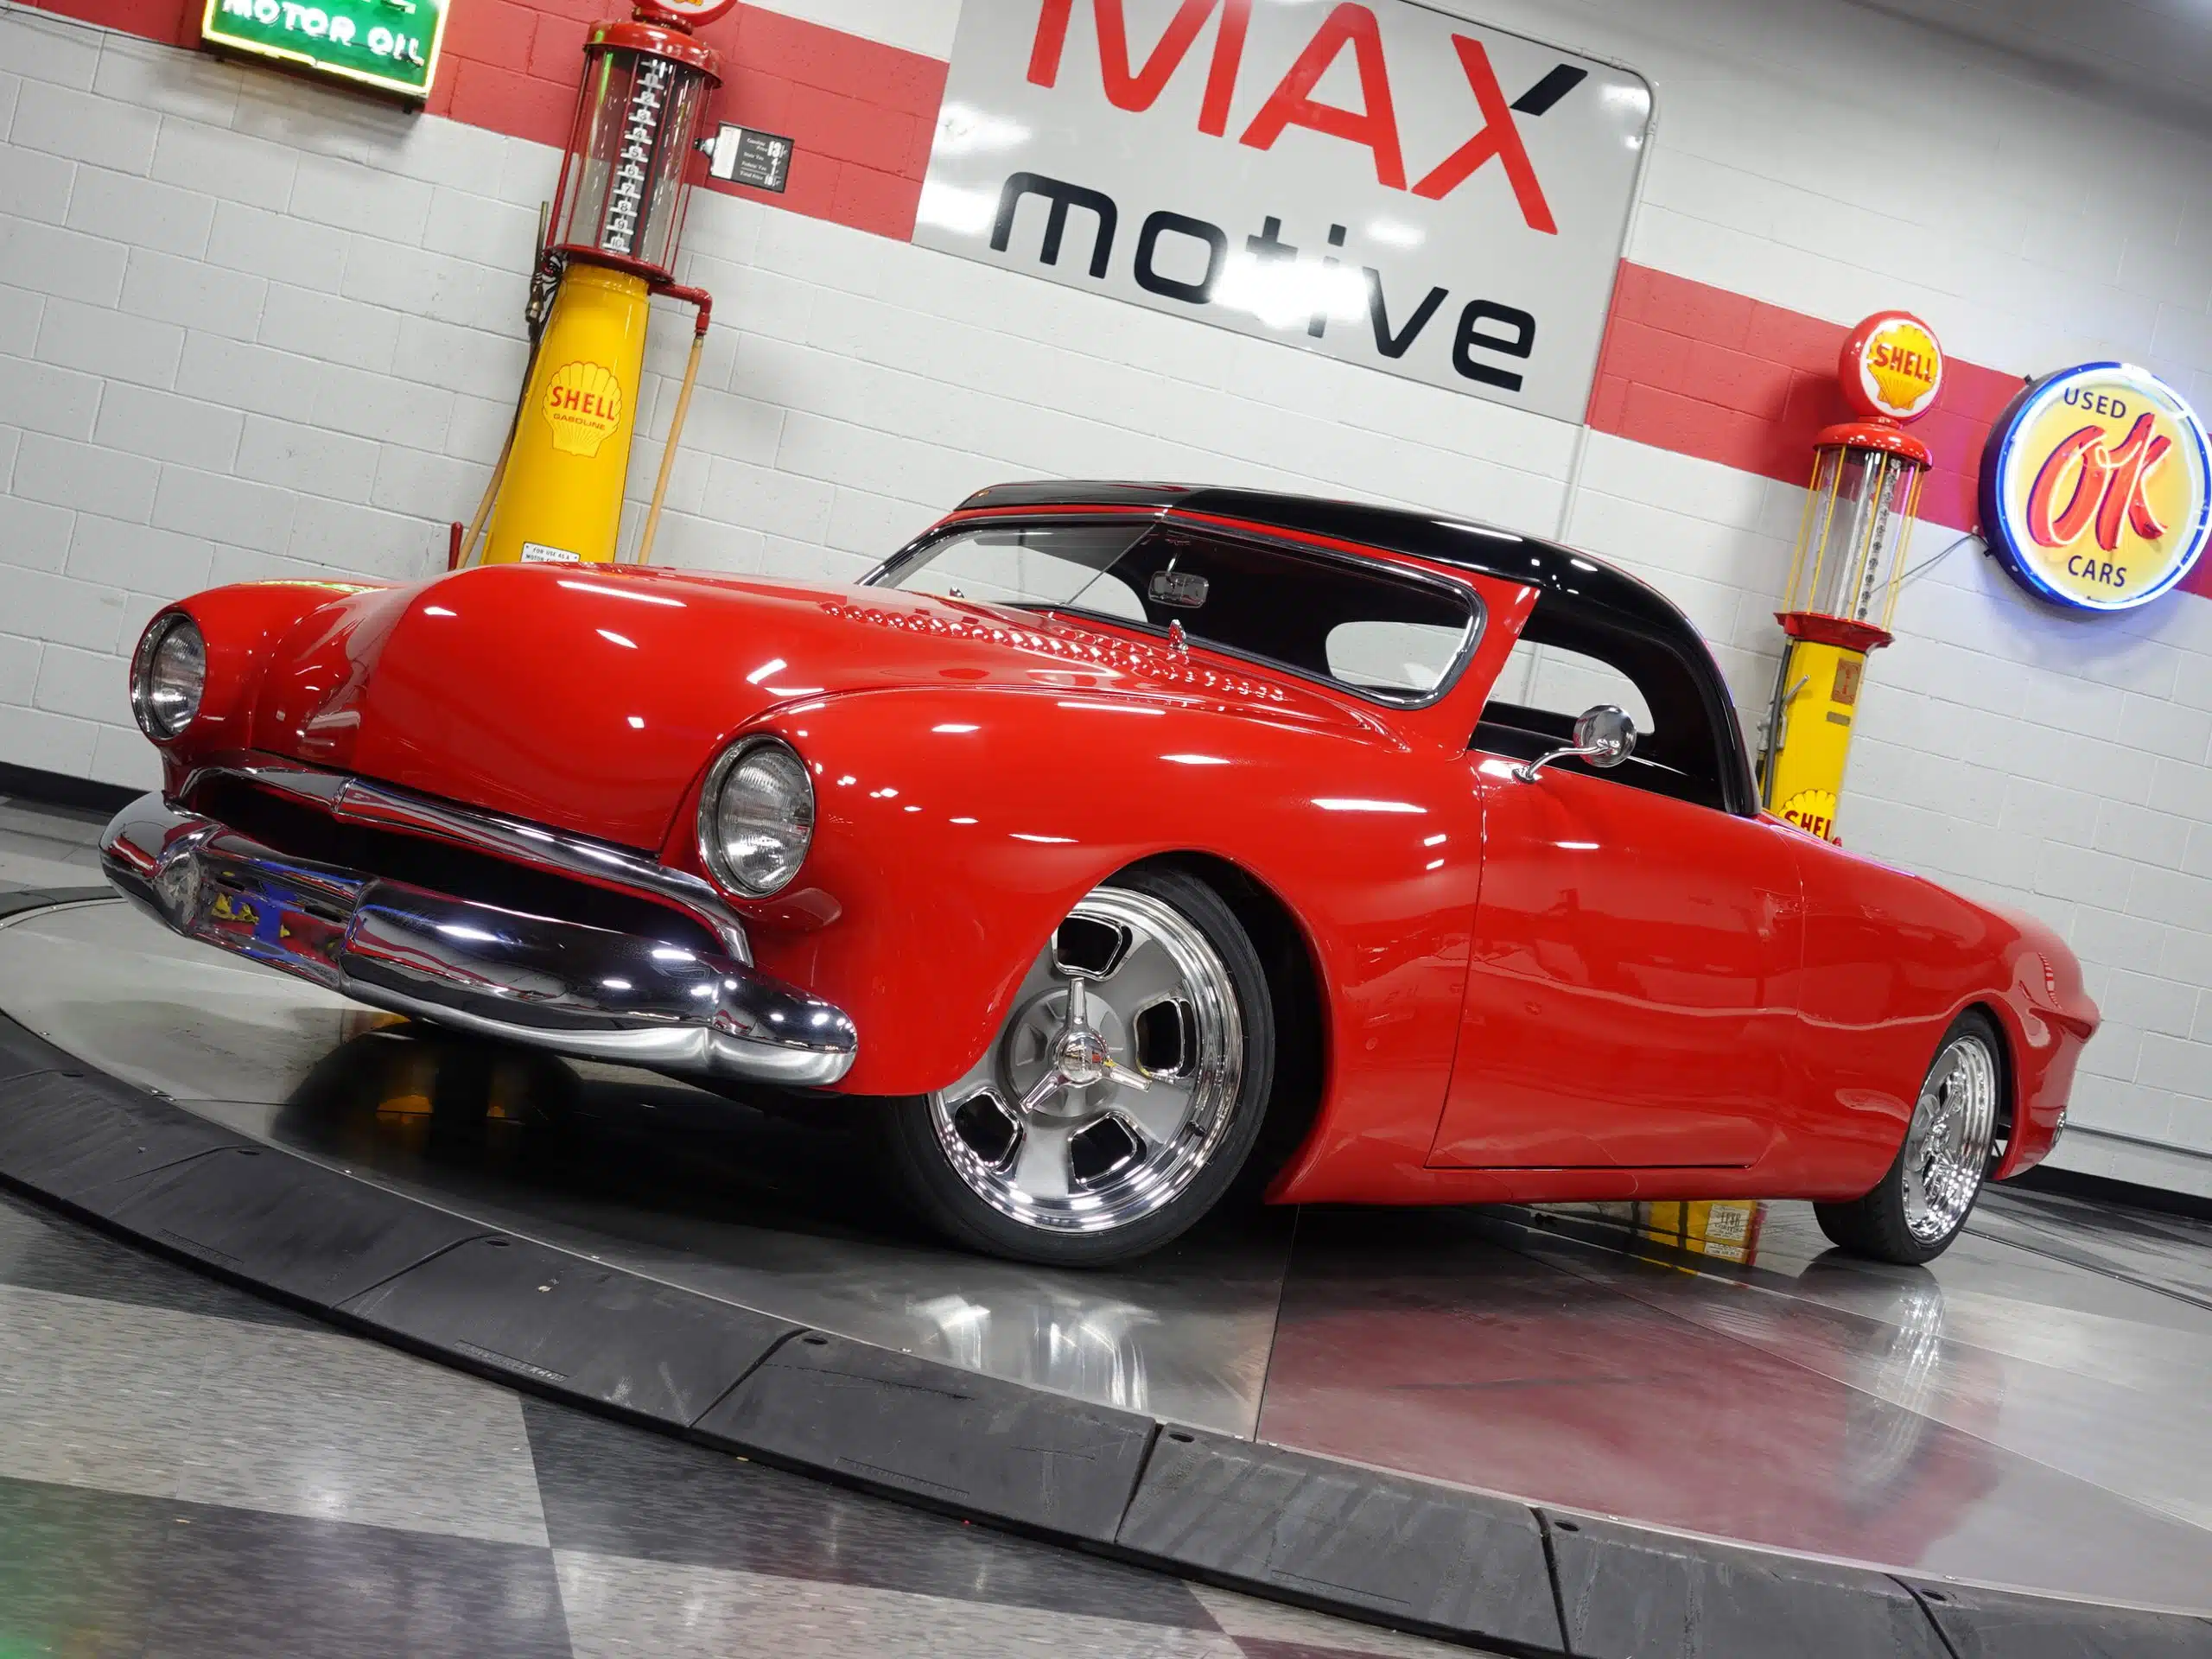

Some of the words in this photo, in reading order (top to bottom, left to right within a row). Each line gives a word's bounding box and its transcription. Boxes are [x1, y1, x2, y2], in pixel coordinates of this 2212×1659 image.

[222, 0, 356, 47] MOTOR
[367, 27, 424, 67] OIL
[1027, 0, 1587, 235] MAX
[990, 172, 1536, 391] motive
[1873, 343, 1933, 384] SHELL
[550, 385, 615, 421] SHELL
[553, 413, 606, 430] GASOLINE
[2063, 387, 2126, 419] USED
[2026, 412, 2171, 552] OK
[2068, 555, 2126, 588] CARS
[1784, 810, 1832, 842] SHEL
